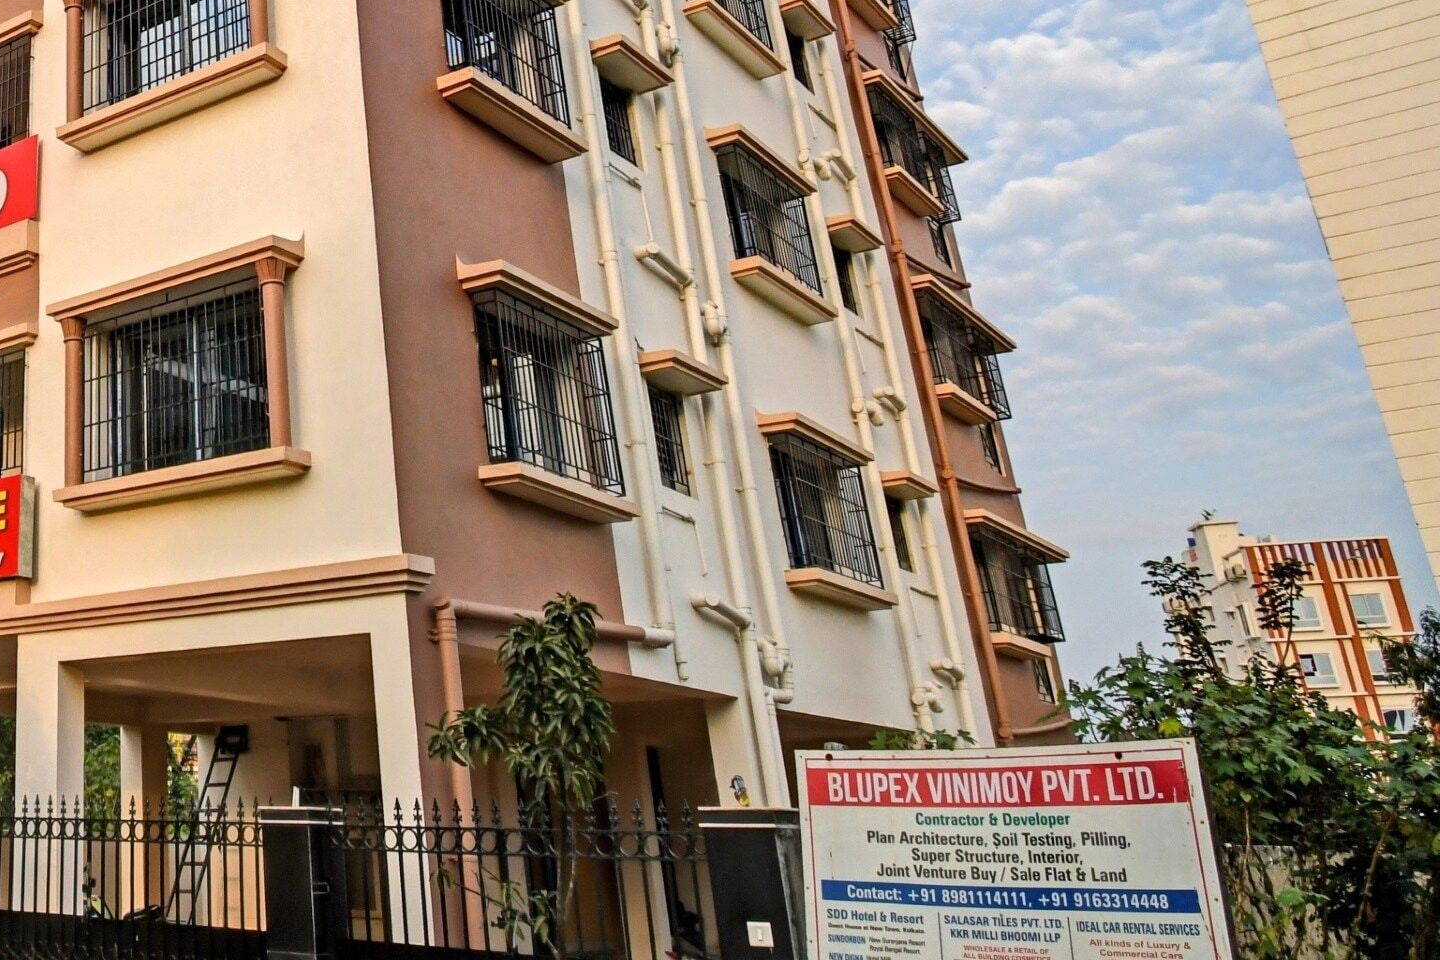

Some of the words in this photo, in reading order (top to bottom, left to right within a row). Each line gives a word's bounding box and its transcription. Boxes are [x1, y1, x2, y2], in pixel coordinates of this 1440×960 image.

[827, 772, 923, 804] BLUPEX
[926, 771, 1033, 804] VINIMOY
[1041, 769, 1100, 802] PVT.
[1104, 766, 1164, 801] LTD.
[915, 812, 984, 826] Contractor
[989, 813, 998, 826] &
[1003, 812, 1071, 828] Developer
[866, 830, 895, 844] Plan
[899, 831, 988, 847] Architecture,
[992, 833, 1018, 847] Soil
[1021, 832, 1076, 849] Testing,
[1081, 832, 1131, 849] Pilling,
[912, 848, 951, 864] Super
[955, 849, 1024, 865] Structure,
[1028, 850, 1083, 865] Interior,
[877, 863, 910, 877] Joint
[913, 865, 967, 880] Venture
[971, 867, 997, 883] Buy
[1010, 867, 1041, 881] Sale
[1045, 868, 1072, 882] Flat
[1076, 868, 1086, 881] &
[1091, 867, 1128, 882] Land
[847, 884, 902, 901] Contact:
[908, 888, 936, 903] +91
[941, 889, 1032, 907] 8981114111,
[1038, 892, 1068, 907] +91
[1073, 893, 1169, 909] 9163314448
[826, 908, 848, 920] SDD
[851, 910, 877, 922] Hotel
[880, 912, 887, 922] &
[890, 912, 924, 924] Resort
[944, 915, 989, 927] SALASAR
[991, 917, 1018, 928] TILES
[1021, 918, 1041, 928] PVT.
[1044, 919, 1064, 929] LTD.
[950, 928, 969, 939] KKR
[972, 930, 998, 940] MILLI
[1001, 931, 1041, 941] BHOOMI
[1044, 933, 1060, 943] LLP
[1076, 921, 1101, 933] IDEAL
[1103, 922, 1121, 934] CAR
[1123, 922, 1157, 935] RENTAL
[1159, 923, 1200, 936] SERVICES
[963, 945, 1005, 953] WHOLESALE
[1089, 939, 1102, 947] All
[1147, 941, 1180, 951] Luxury
[1183, 942, 1191, 950] &
[1099, 949, 1158, 958] Commercial
[1160, 951, 1184, 960] Cars
